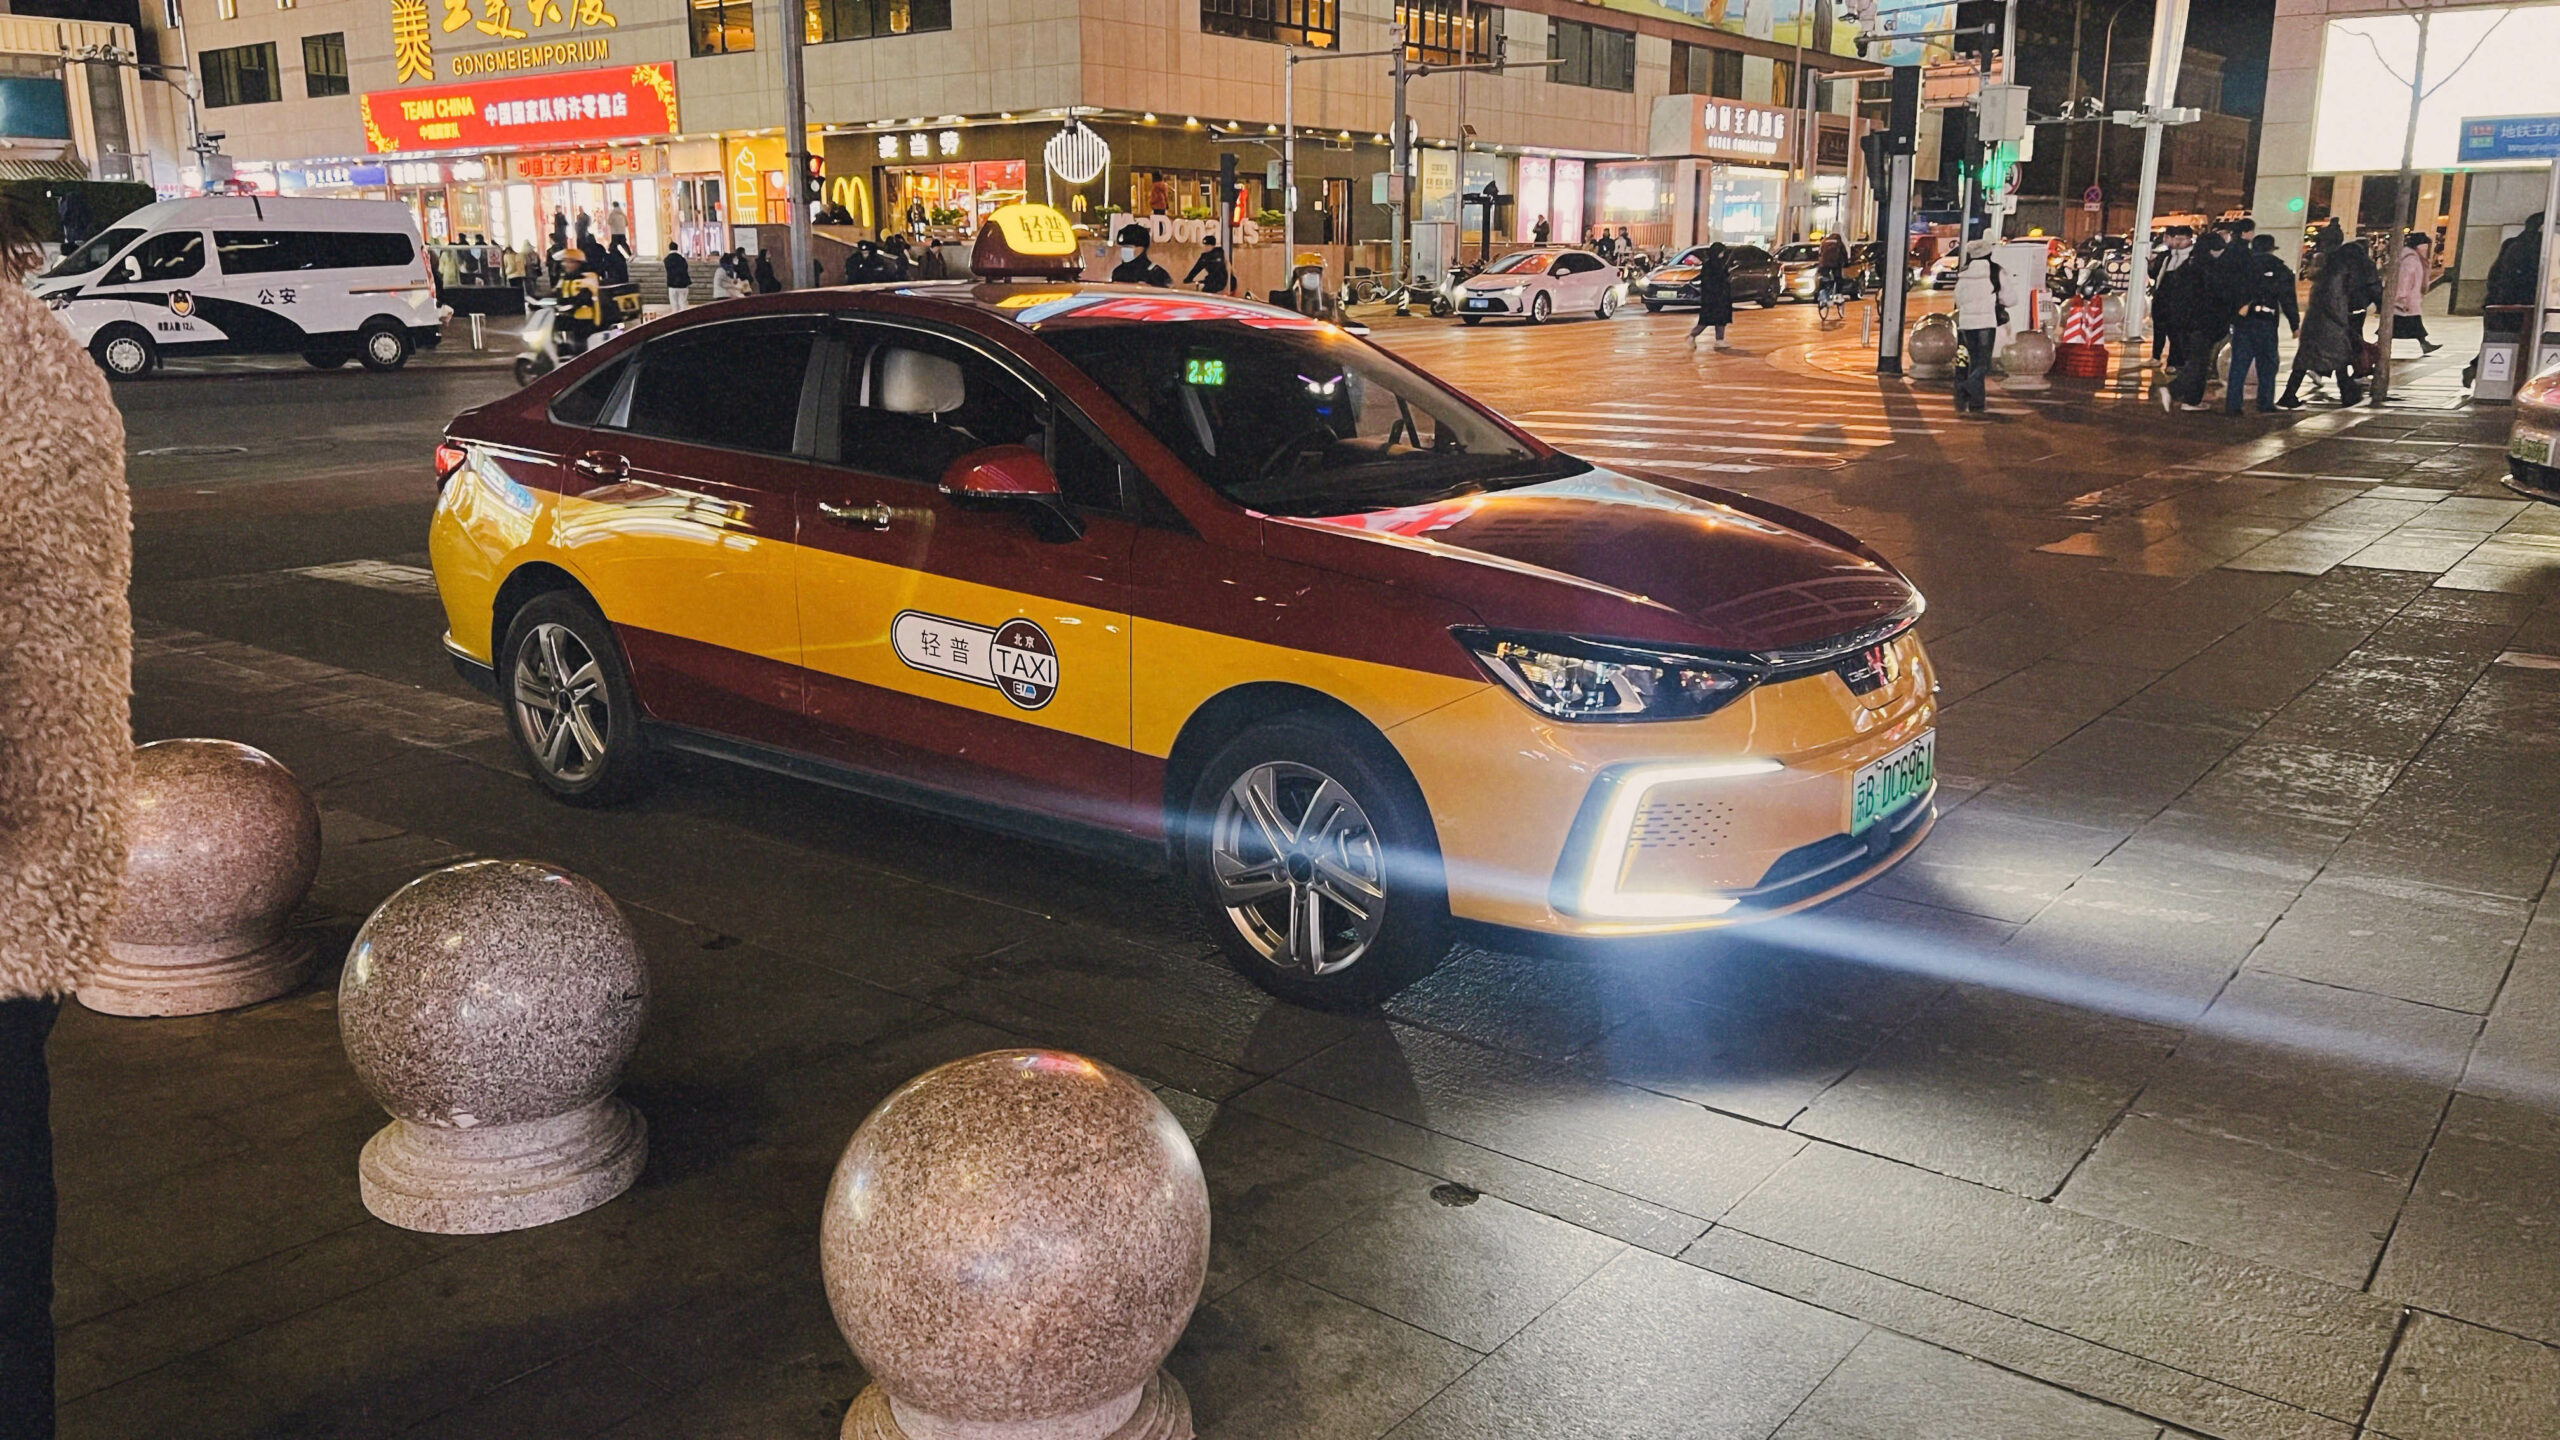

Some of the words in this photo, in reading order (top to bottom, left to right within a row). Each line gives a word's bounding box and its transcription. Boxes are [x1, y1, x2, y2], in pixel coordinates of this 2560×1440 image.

[400, 99, 435, 121] TEAM
[435, 96, 476, 118] CHINA
[878, 130, 960, 158] 麦当劳
[1019, 215, 1066, 243] 轻普
[258, 288, 296, 305] 公安
[1188, 360, 1224, 385] 2.3元
[921, 629, 970, 665] 轻普
[1013, 632, 1036, 649] 北京
[996, 648, 1053, 684] TAXI
